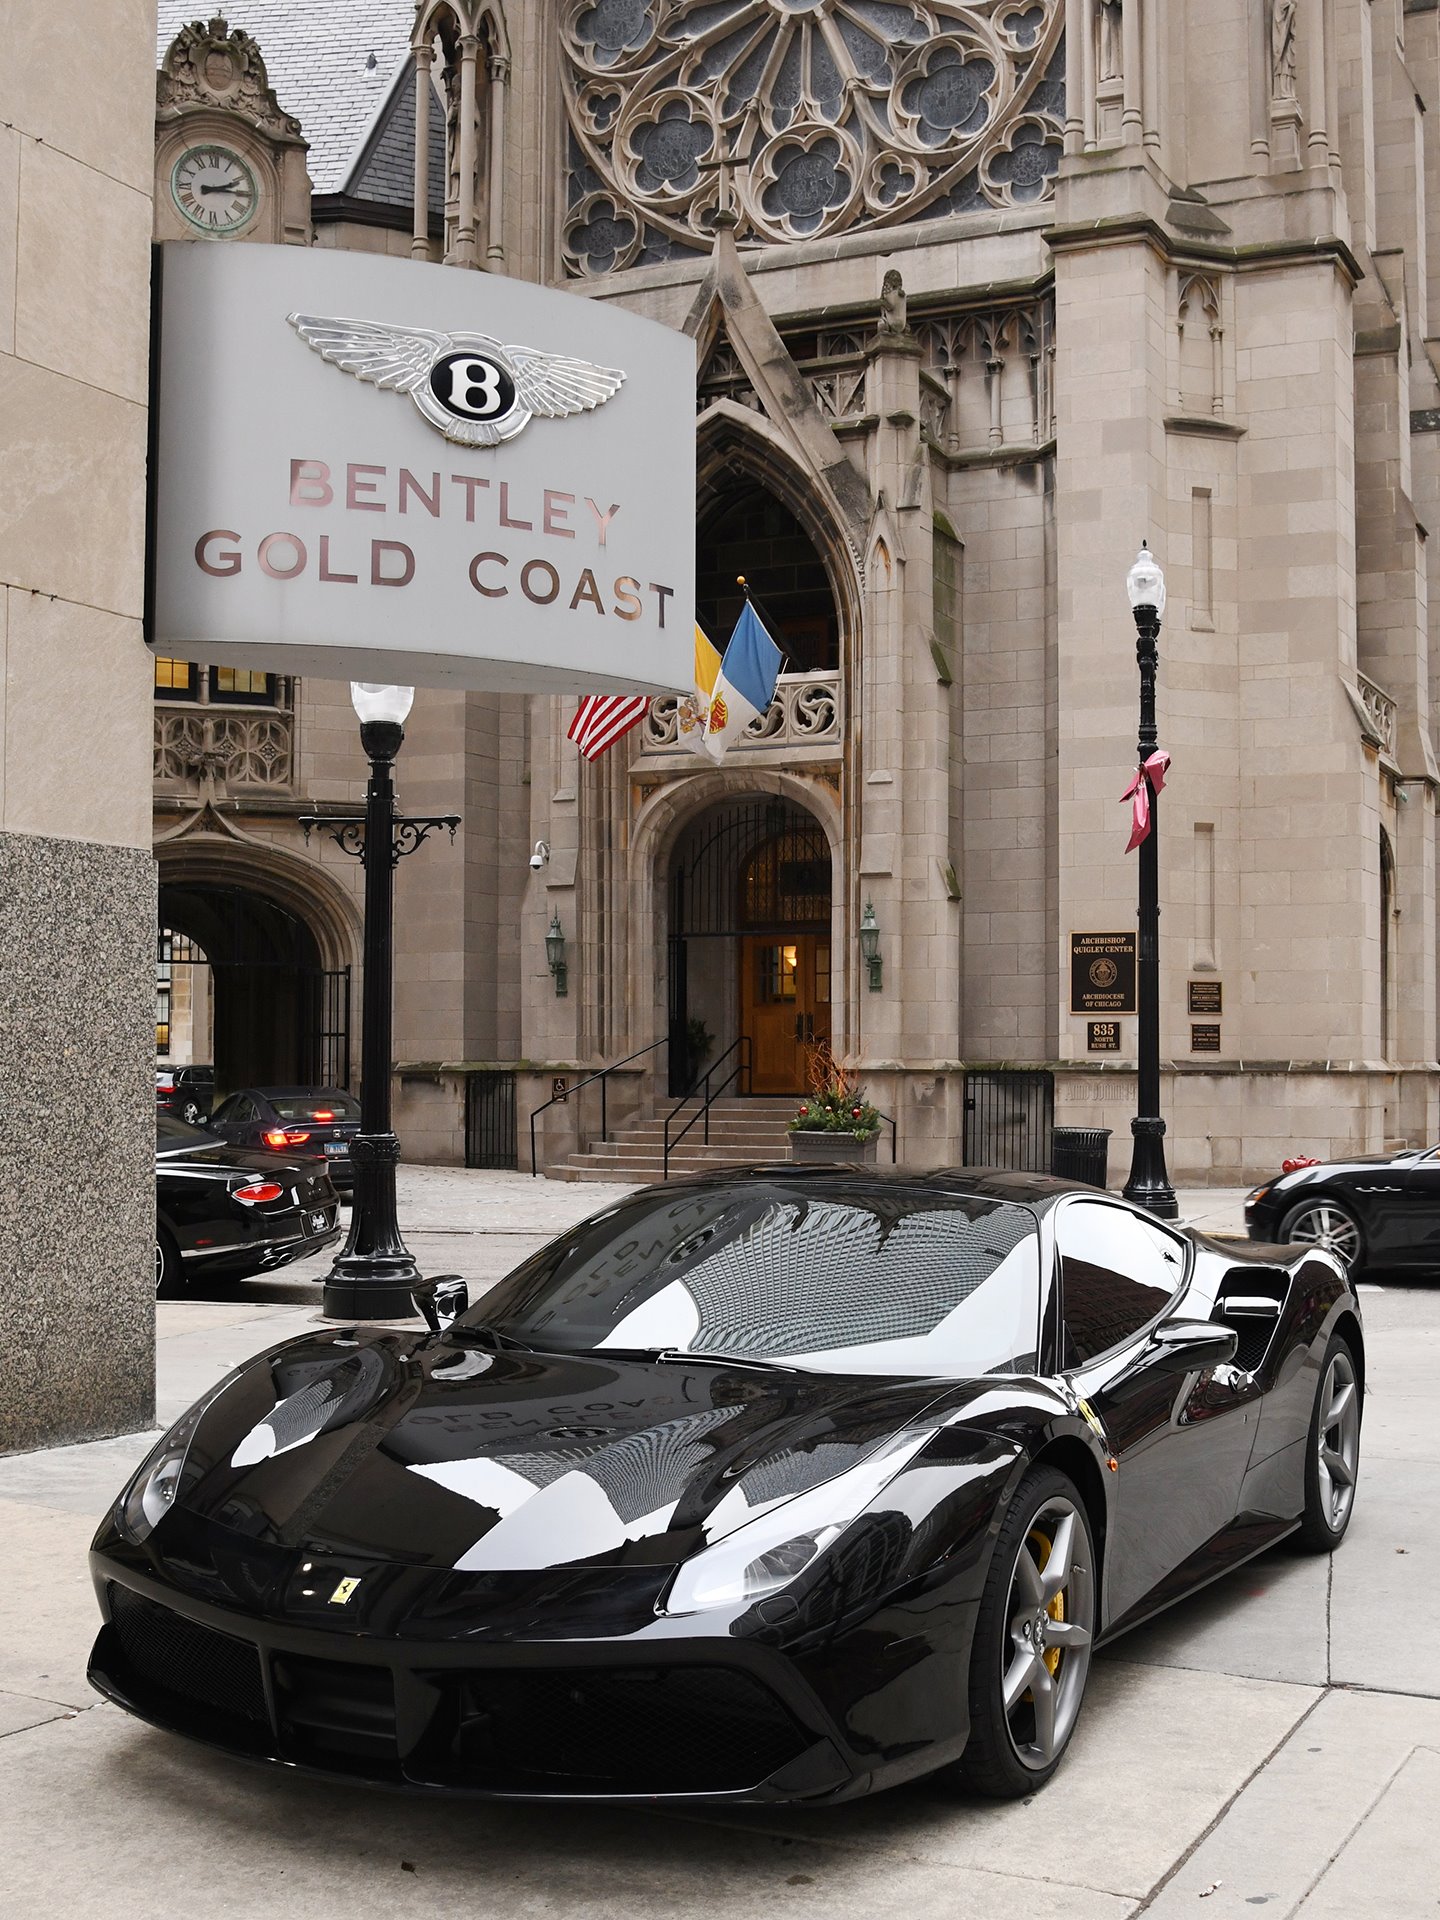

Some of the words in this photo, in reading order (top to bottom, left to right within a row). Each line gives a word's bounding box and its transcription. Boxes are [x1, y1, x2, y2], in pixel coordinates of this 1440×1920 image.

[208, 155, 220, 169] XII
[448, 358, 501, 414] B
[289, 458, 621, 546] BENTLEY
[194, 529, 416, 588] GOLD
[468, 551, 675, 629] COAST
[1080, 937, 1126, 945] ARCHBISHOP
[1073, 946, 1104, 954] QUIGLEY
[1093, 1023, 1115, 1036] 835
